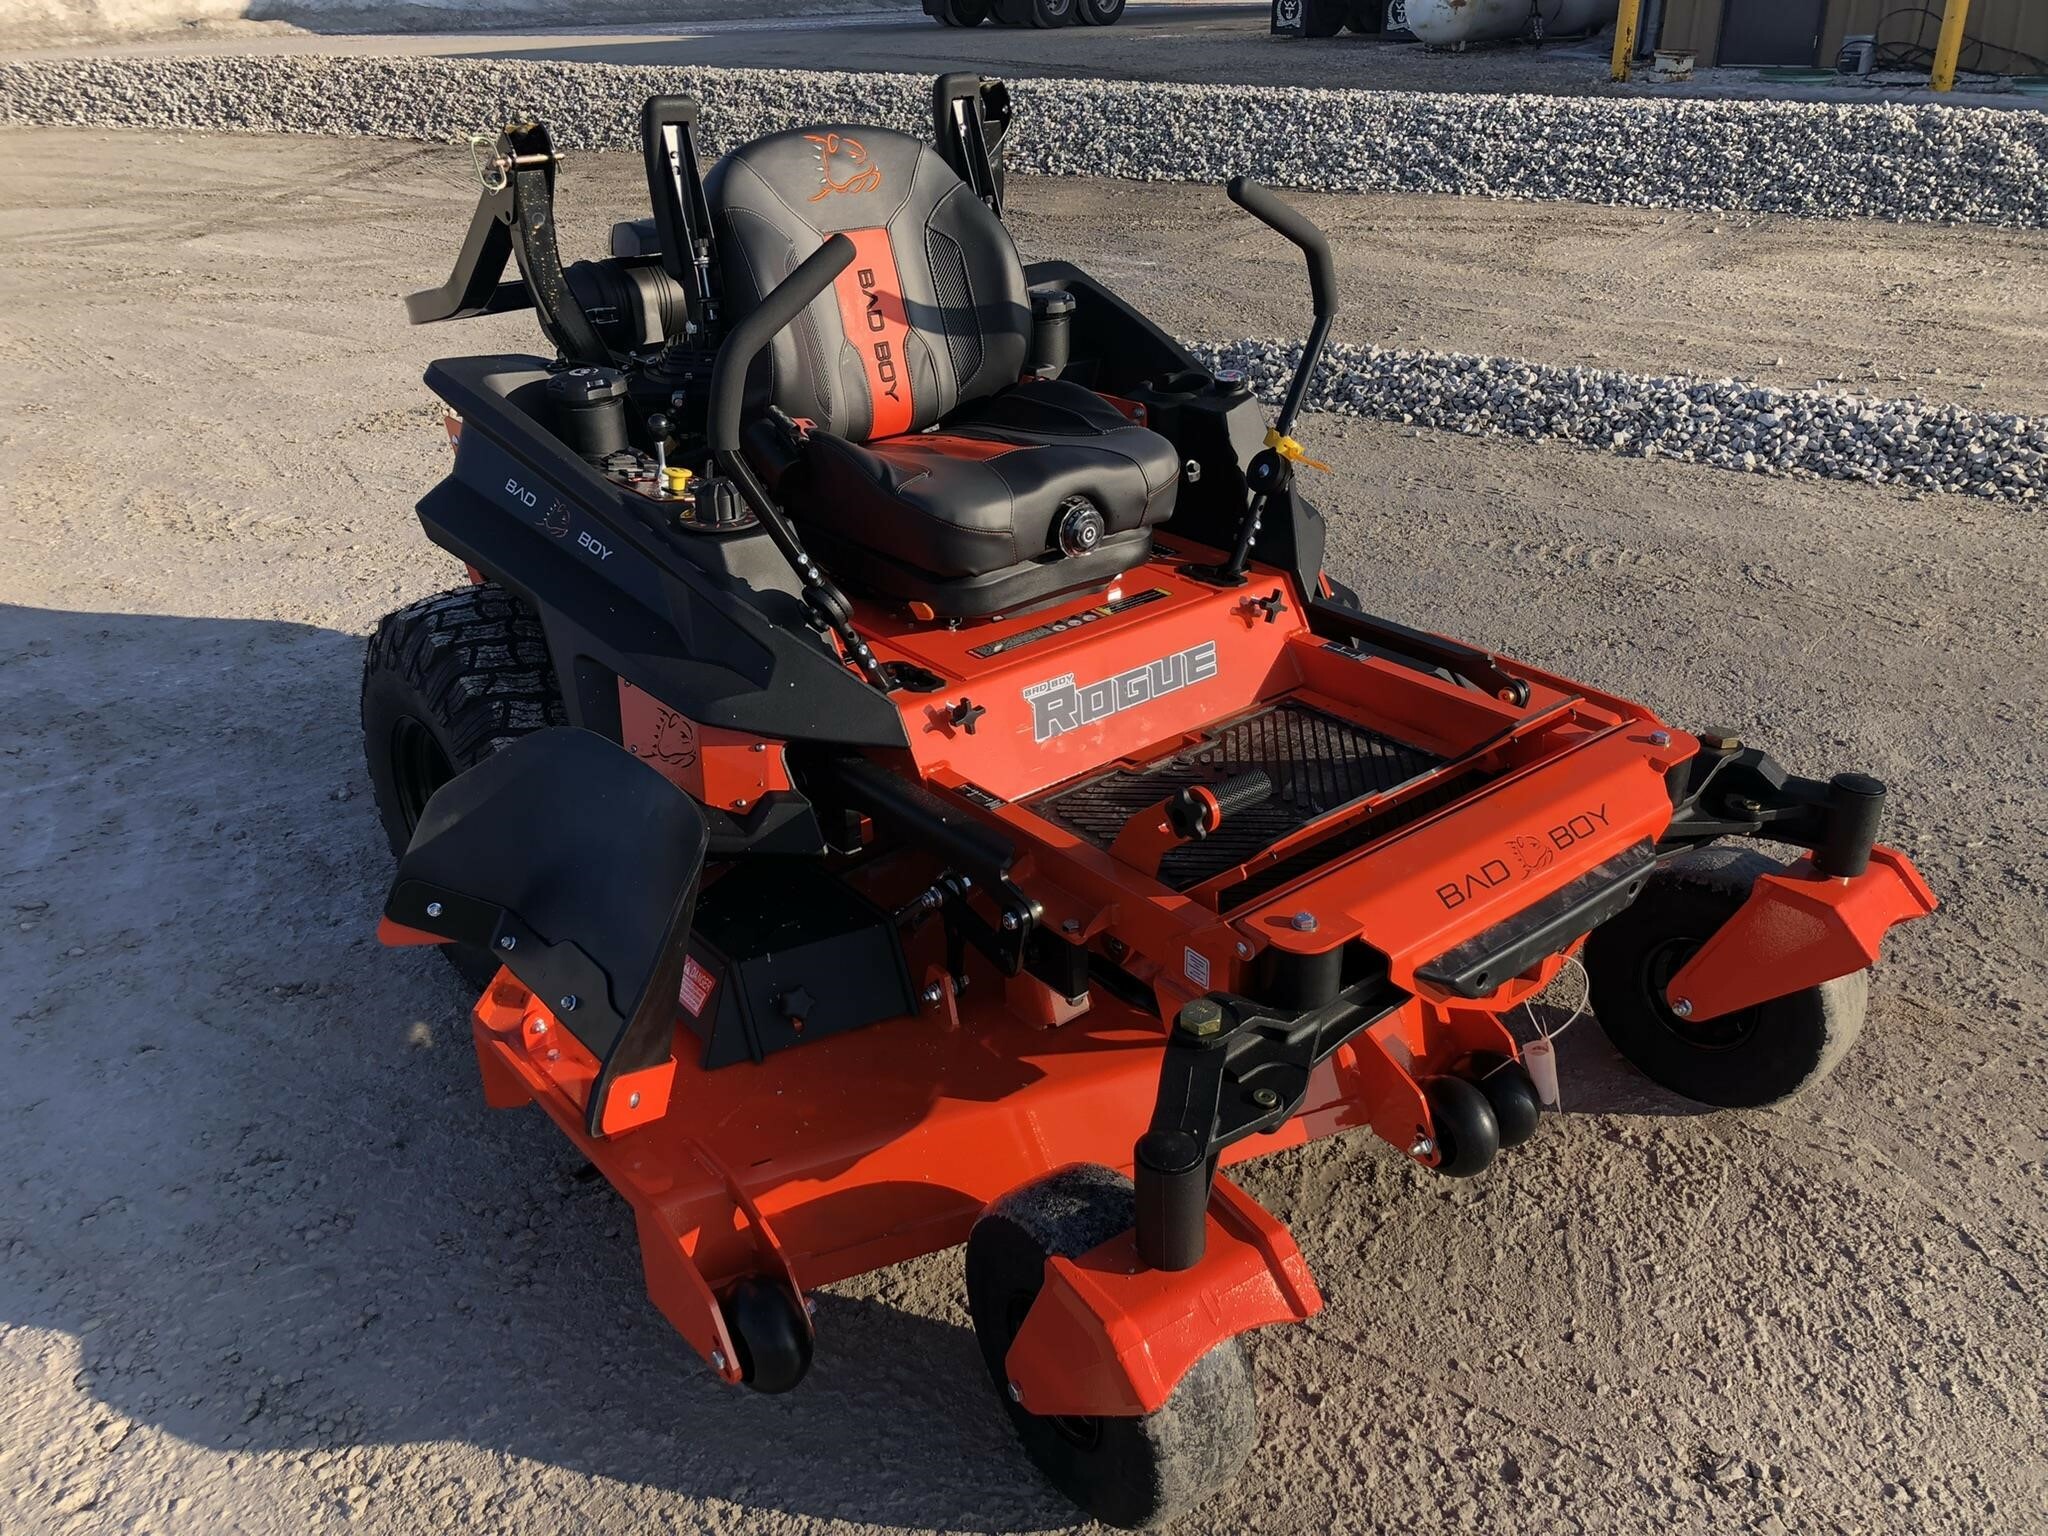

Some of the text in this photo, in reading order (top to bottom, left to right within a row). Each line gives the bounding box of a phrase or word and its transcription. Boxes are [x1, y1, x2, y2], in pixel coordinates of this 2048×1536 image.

[857, 268, 900, 403] BAD BOY
[505, 478, 614, 560] BAD BOY
[1023, 672, 1075, 699] BAD BOY
[1028, 640, 1218, 743] ROGUE
[1436, 803, 1609, 910] BAD BOY
